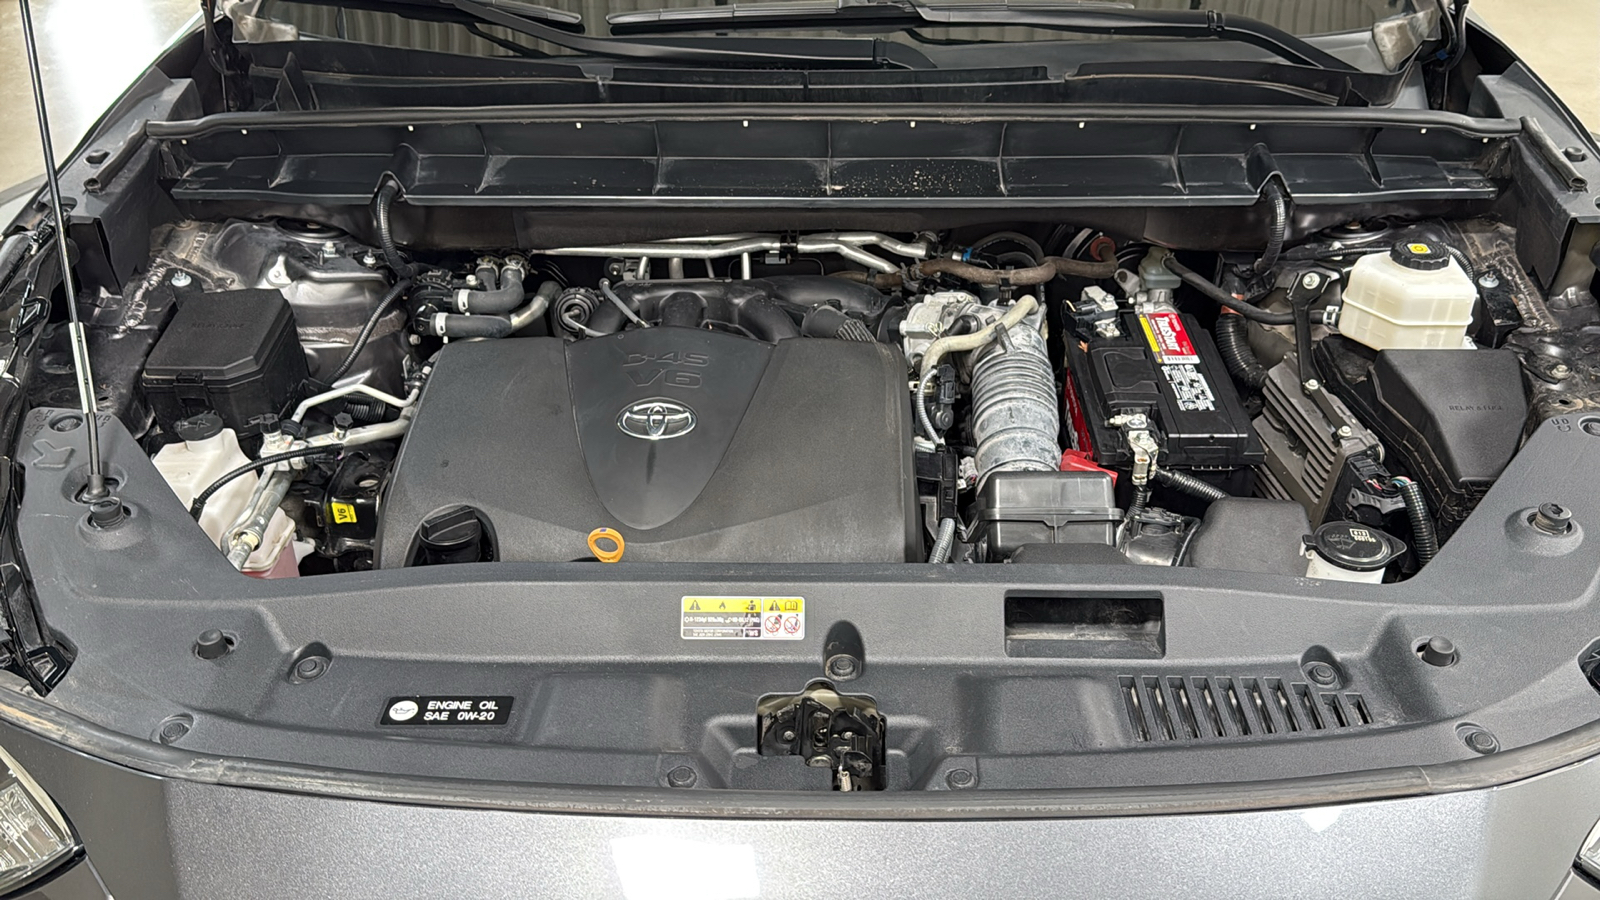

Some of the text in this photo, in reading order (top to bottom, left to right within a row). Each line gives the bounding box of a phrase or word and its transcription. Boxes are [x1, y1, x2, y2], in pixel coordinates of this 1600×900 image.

[624, 368, 703, 389] V6
[337, 508, 348, 520] V6
[427, 700, 499, 710] ENGINE OIL
[423, 711, 496, 721] SAE 0W-20
